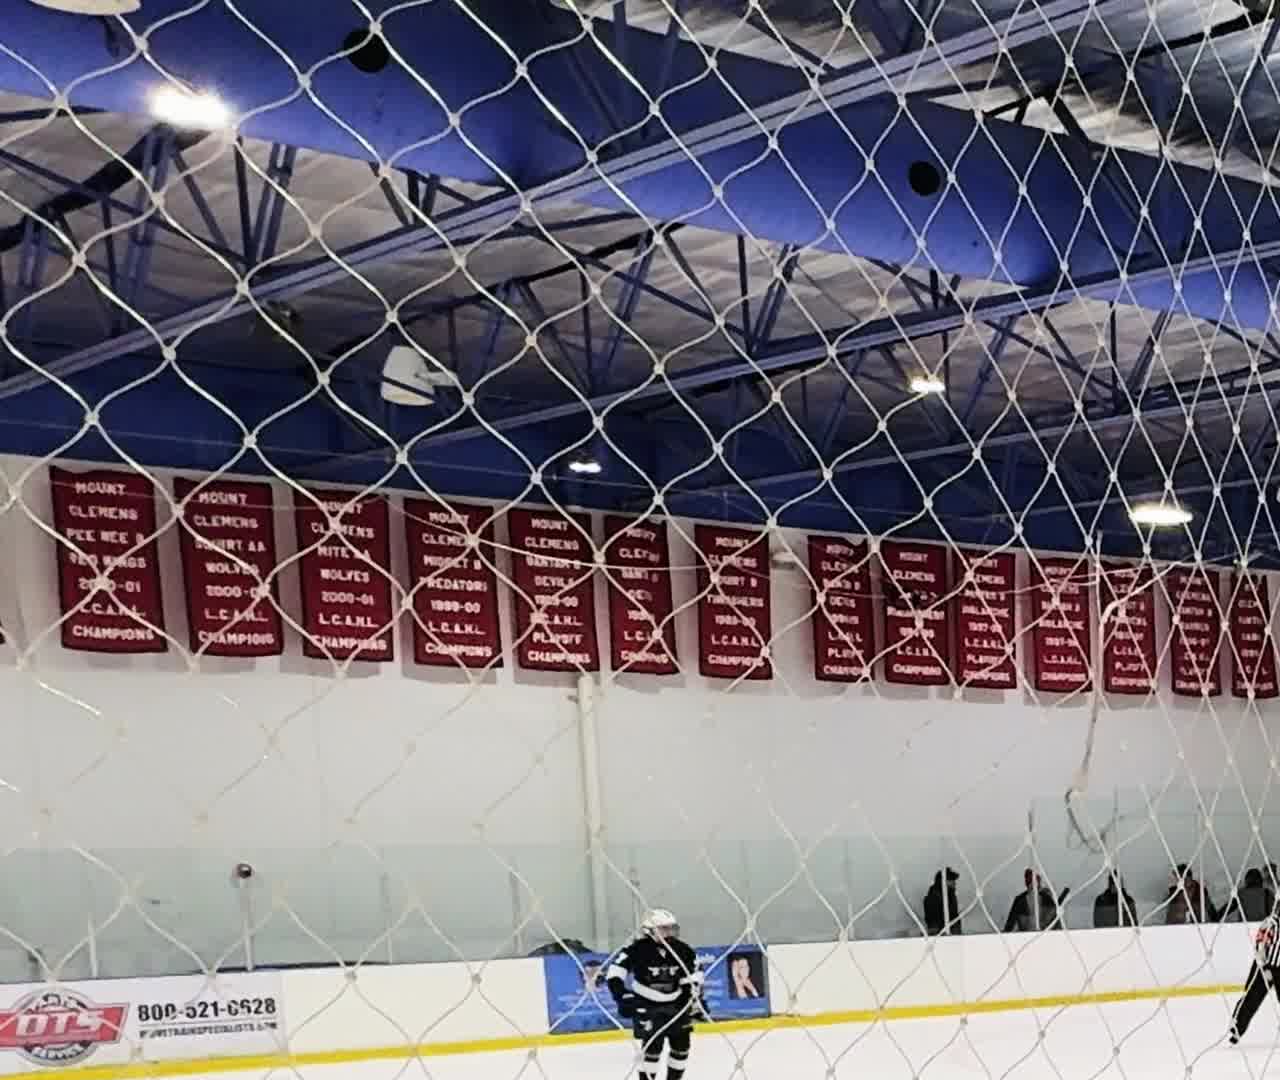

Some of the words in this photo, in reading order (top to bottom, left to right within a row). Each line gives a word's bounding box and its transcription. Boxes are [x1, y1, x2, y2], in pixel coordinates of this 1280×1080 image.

[75, 483, 126, 496] MOUNT
[199, 491, 248, 505] MOUNT
[69, 505, 138, 520] CLEMENS
[193, 515, 259, 528] CLEMENS
[531, 519, 569, 531] MOUNT
[67, 528, 96, 542] PEE
[524, 537, 580, 551] CLEMENS
[320, 569, 370, 583] WOLVES
[72, 625, 155, 640] CHAMPIONS
